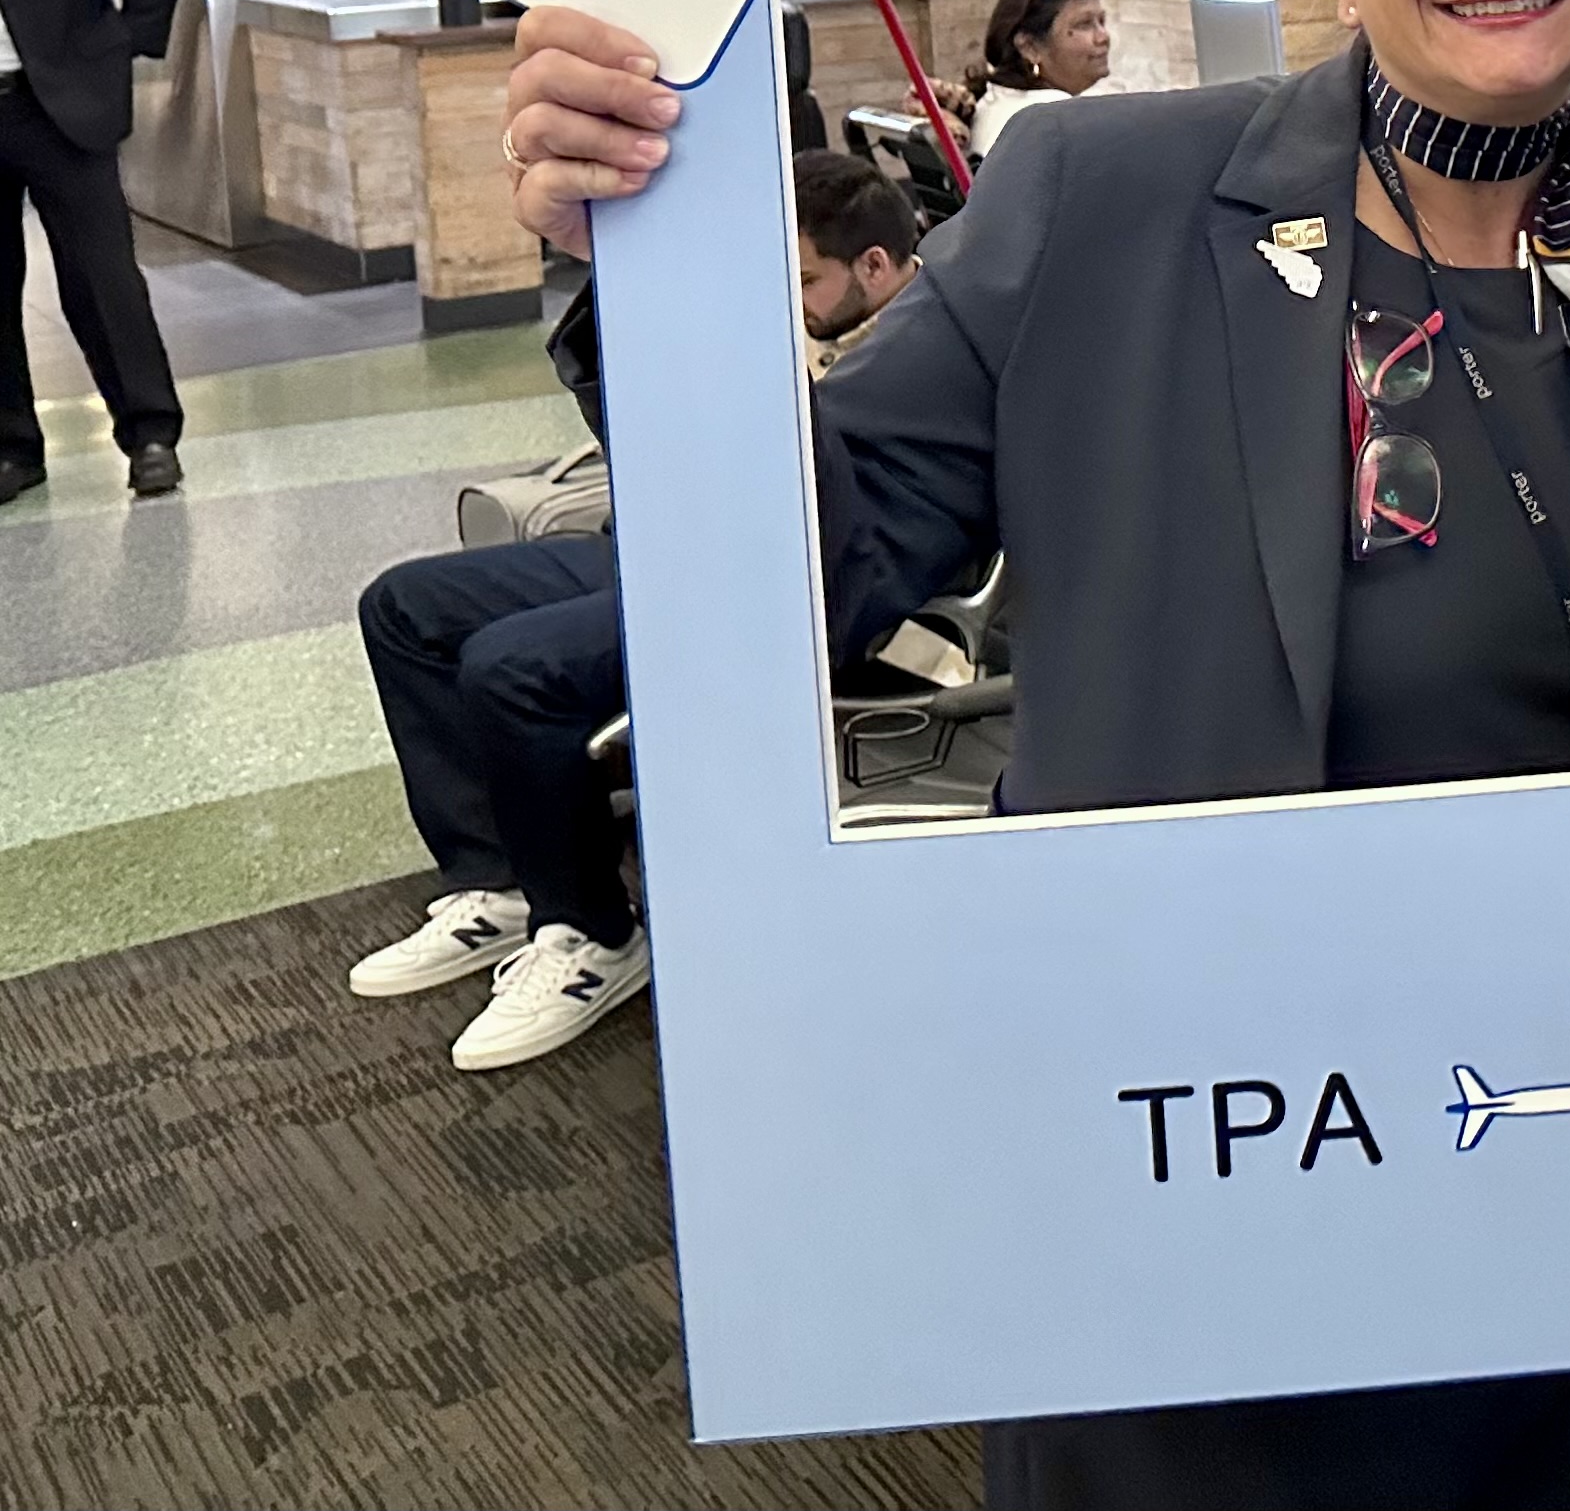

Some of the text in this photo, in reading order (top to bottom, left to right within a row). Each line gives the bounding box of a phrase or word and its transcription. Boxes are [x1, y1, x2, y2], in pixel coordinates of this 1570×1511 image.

[1370, 144, 1404, 198] porter
[1458, 345, 1494, 400] porter
[1511, 470, 1546, 526] porter
[1117, 1072, 1383, 1183] TPA
